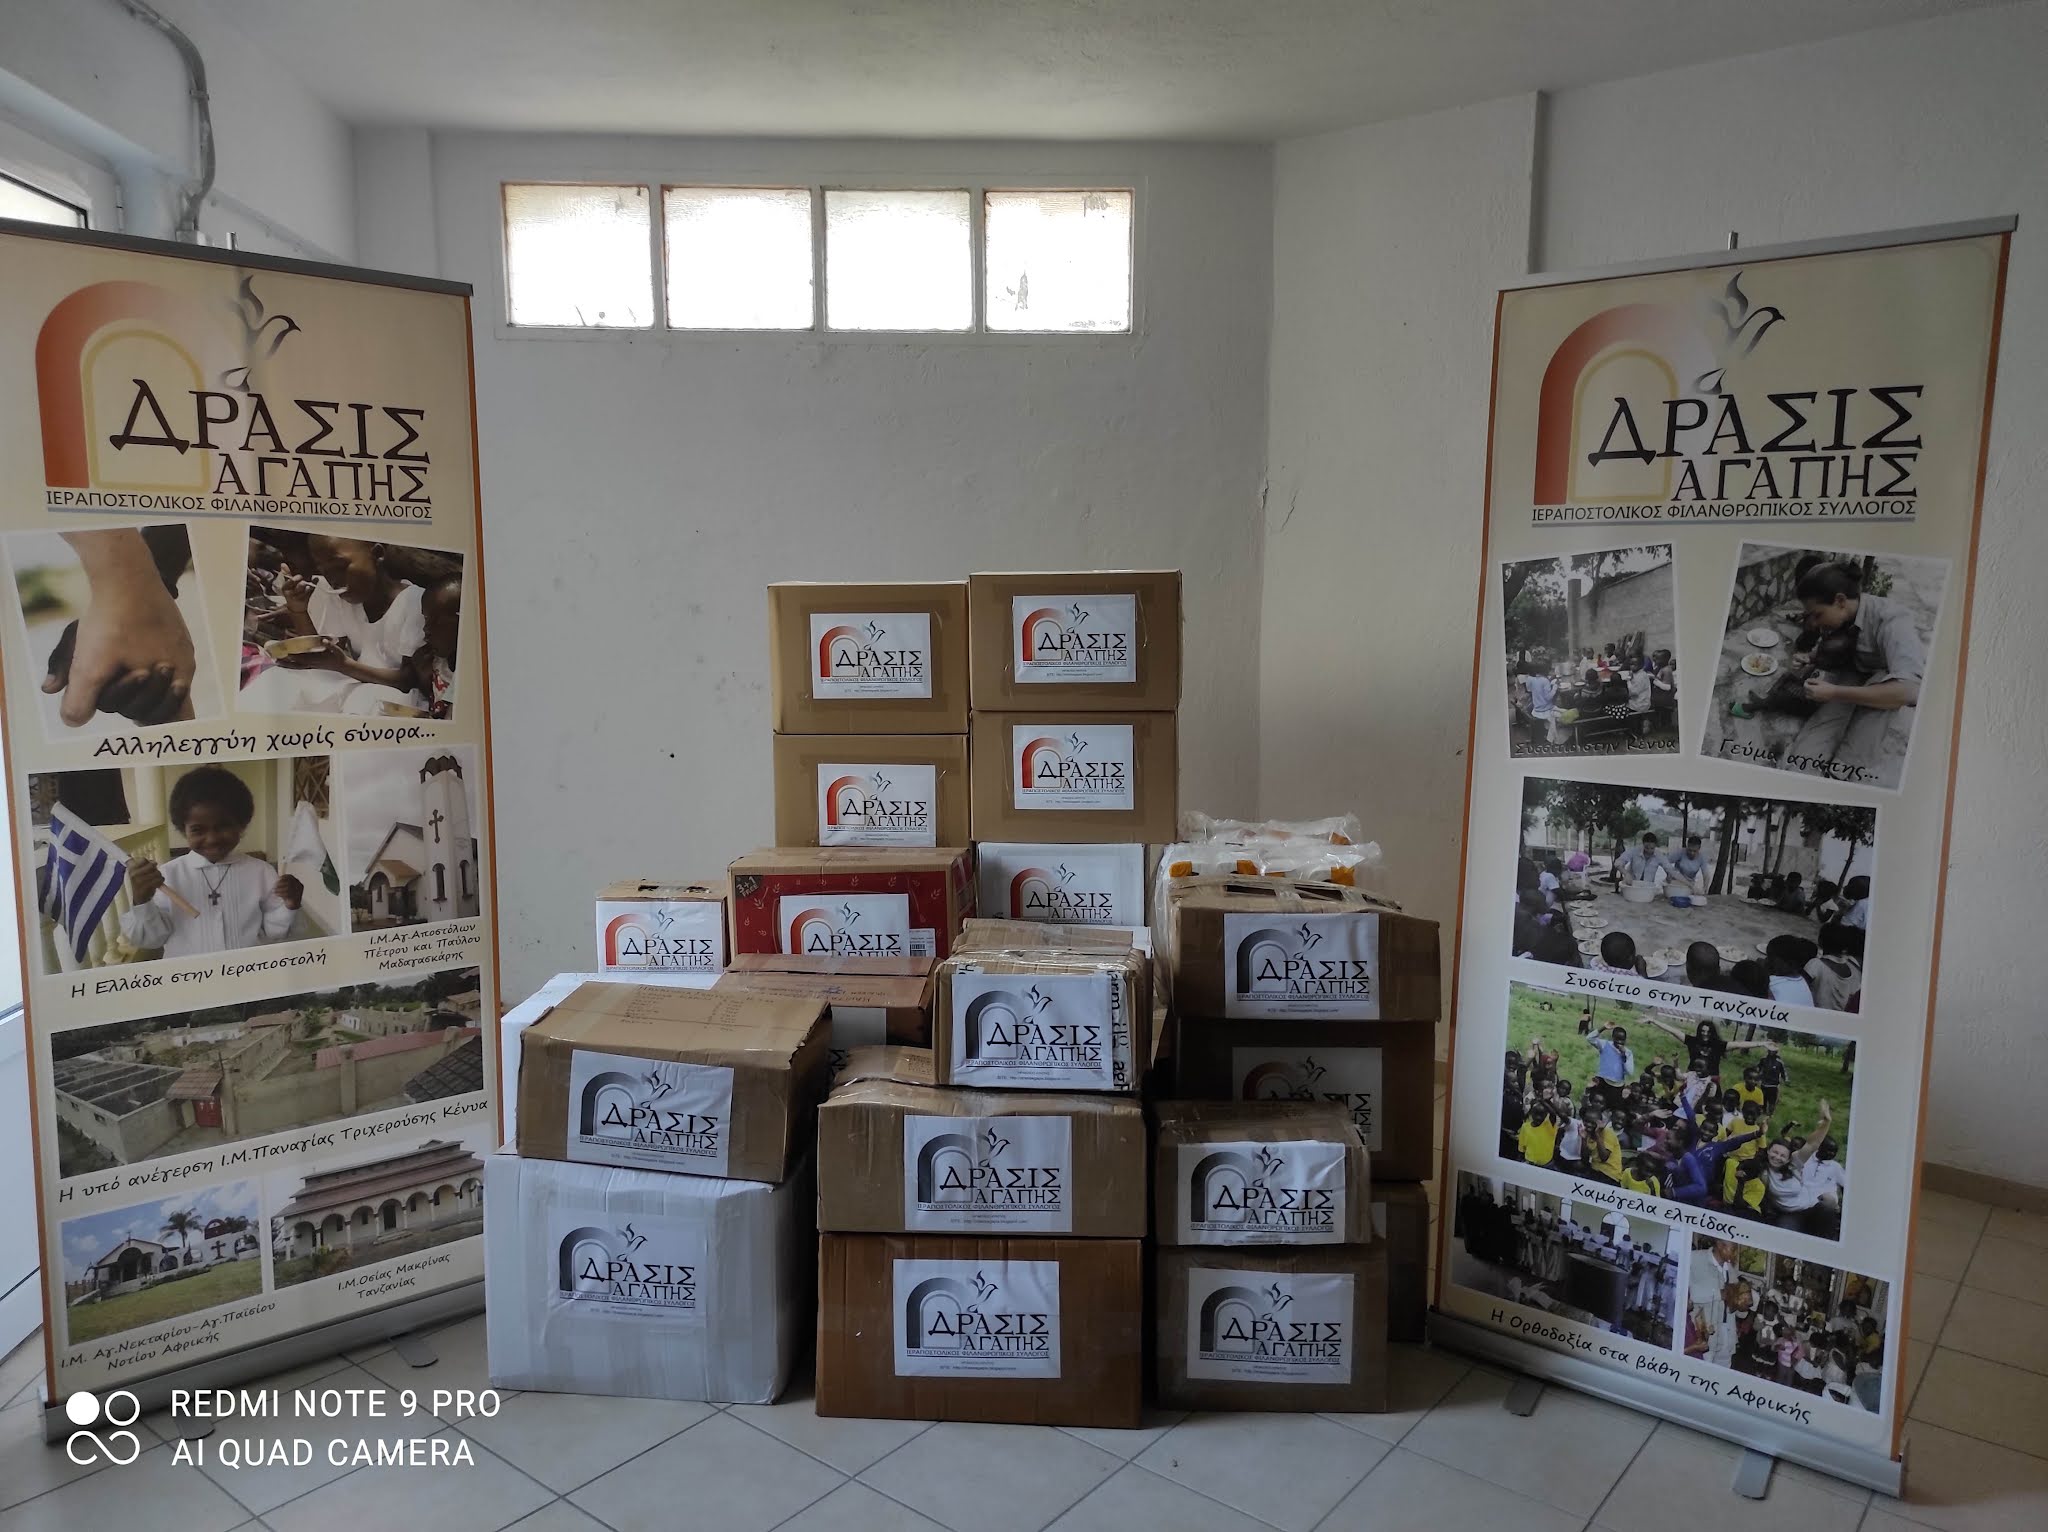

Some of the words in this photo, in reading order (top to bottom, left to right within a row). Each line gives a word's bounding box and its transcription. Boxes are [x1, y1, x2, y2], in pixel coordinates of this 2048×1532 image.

[109, 378, 430, 463] ΔΡΑΣΙΣ
[1587, 385, 1924, 466] ΔΡΑΣΙΣ
[212, 453, 431, 504] ΑΓΑΠΗΣ
[1671, 453, 1918, 500] ΑΓΑΠΗΣ
[46, 490, 204, 510] ΙΕΡΑΠΟΣΤΟΛΙΚΟΣ
[211, 498, 350, 516] ΦΙΛΑΝΘΡΩΠΙΚΟΣ
[355, 503, 432, 518] ΣΥΛΛΟΓΟΣ
[1532, 505, 1662, 521] ΙΕΡΑΠΟΣΤΟΛΙΚΟΣ
[1667, 502, 1813, 519] ΦΙΛΑΝΘΡΩΠΙΚΟΣ
[1818, 500, 1916, 516] ΣΥΛΛΟΓΟΣ
[1038, 632, 1127, 651] ΔΡΑΣΙΣ
[836, 649, 923, 668] ΔΡΑΣΙΣ
[1064, 650, 1127, 661] ΑΓΑΠΗΣ
[861, 667, 923, 677] ΑΓΑΠΗΣ
[94, 730, 256, 757] Αλληλεγγύη
[267, 725, 335, 750] χωρίς
[345, 723, 436, 745] σύνορα...
[1038, 761, 1125, 778] ΔΡΑΣΙΣ
[1719, 739, 1778, 763] Γεύμα
[1787, 753, 1879, 781] αγάπης...
[1063, 778, 1125, 788] ΑΓΑΠΗΣ
[842, 798, 928, 816] ΔΡΑΣΙΣ
[865, 816, 928, 827] ΑΓΑΠΗΣ
[736, 875, 756, 893] 3+1
[1026, 891, 1112, 909] ΔΡΑΣΙΣ
[1051, 908, 1112, 919] ΑΓΑΠΗΣ
[364, 946, 408, 959] Πέτρου
[413, 941, 432, 952] και
[437, 935, 481, 949] Παύλου
[622, 937, 714, 956] ΔΡΑΣΙΣ
[808, 933, 901, 952] ΔΡΑΣΙΣ
[378, 950, 464, 970] Μαδαγασκάρης
[649, 955, 714, 966] ΑΓΑΠΗΣ
[1256, 958, 1369, 981] ΔΡΑΣΙΣ
[71, 983, 85, 998] Η
[96, 974, 163, 995] Ελλάδα
[171, 969, 213, 984] στην
[221, 948, 327, 980] Ιεραποστολή
[1289, 980, 1369, 994] ΑΓΑΠΗΣ
[1565, 972, 1641, 996] Συσσίτιο
[1648, 990, 1691, 1008] στην
[1699, 995, 1789, 1022] Τανζανία
[986, 1022, 1102, 1047] ΔΡΑΣΙΣ
[1020, 1045, 1102, 1061] ΑΓΑΠΗΣ
[601, 1102, 719, 1137] ΔΡΑΣΙΣ
[634, 1128, 718, 1150] ΑΓΑΠΗΣ
[60, 1186, 73, 1202] Η
[82, 1176, 120, 1196] υπό
[128, 1160, 213, 1187] ανέγερση
[341, 1110, 437, 1138] Τριχερούσης
[443, 1099, 488, 1118] Κένυα
[940, 1166, 1061, 1190] ΔΡΑΣΙΣ
[975, 1189, 1061, 1204] ΑΓΑΠΗΣ
[1213, 1185, 1334, 1210] ΔΡΑΣΙΣ
[1248, 1209, 1334, 1225] ΑΓΑΠΗΣ
[1571, 1182, 1657, 1215] Χαμόγελα
[1664, 1208, 1750, 1239] ελπίδας...
[396, 1253, 451, 1274] Μακρίνας
[580, 1257, 696, 1287] ΔΡΑΣΙΣ
[357, 1276, 416, 1298] Τανζανίας
[613, 1282, 696, 1301] ΑΓΑΠΗΣ
[928, 1310, 1049, 1336] ΔΡΑΣΙΣ
[1221, 1317, 1342, 1343] ΔΡΑΣΙΣ
[108, 1350, 156, 1370] Νοτίου
[162, 1330, 220, 1355] Αφρικής
[963, 1335, 1049, 1351] ΑΓΑΠΗΣ
[1257, 1341, 1341, 1357] ΑΓΑΠΗΣ
[1491, 1309, 1504, 1323] Η
[1510, 1316, 1592, 1351] Ορθοδοξία
[1599, 1346, 1629, 1363] στα
[1636, 1355, 1680, 1382] βάθη
[1689, 1374, 1719, 1395] της
[1727, 1385, 1811, 1424] Αφρικής
